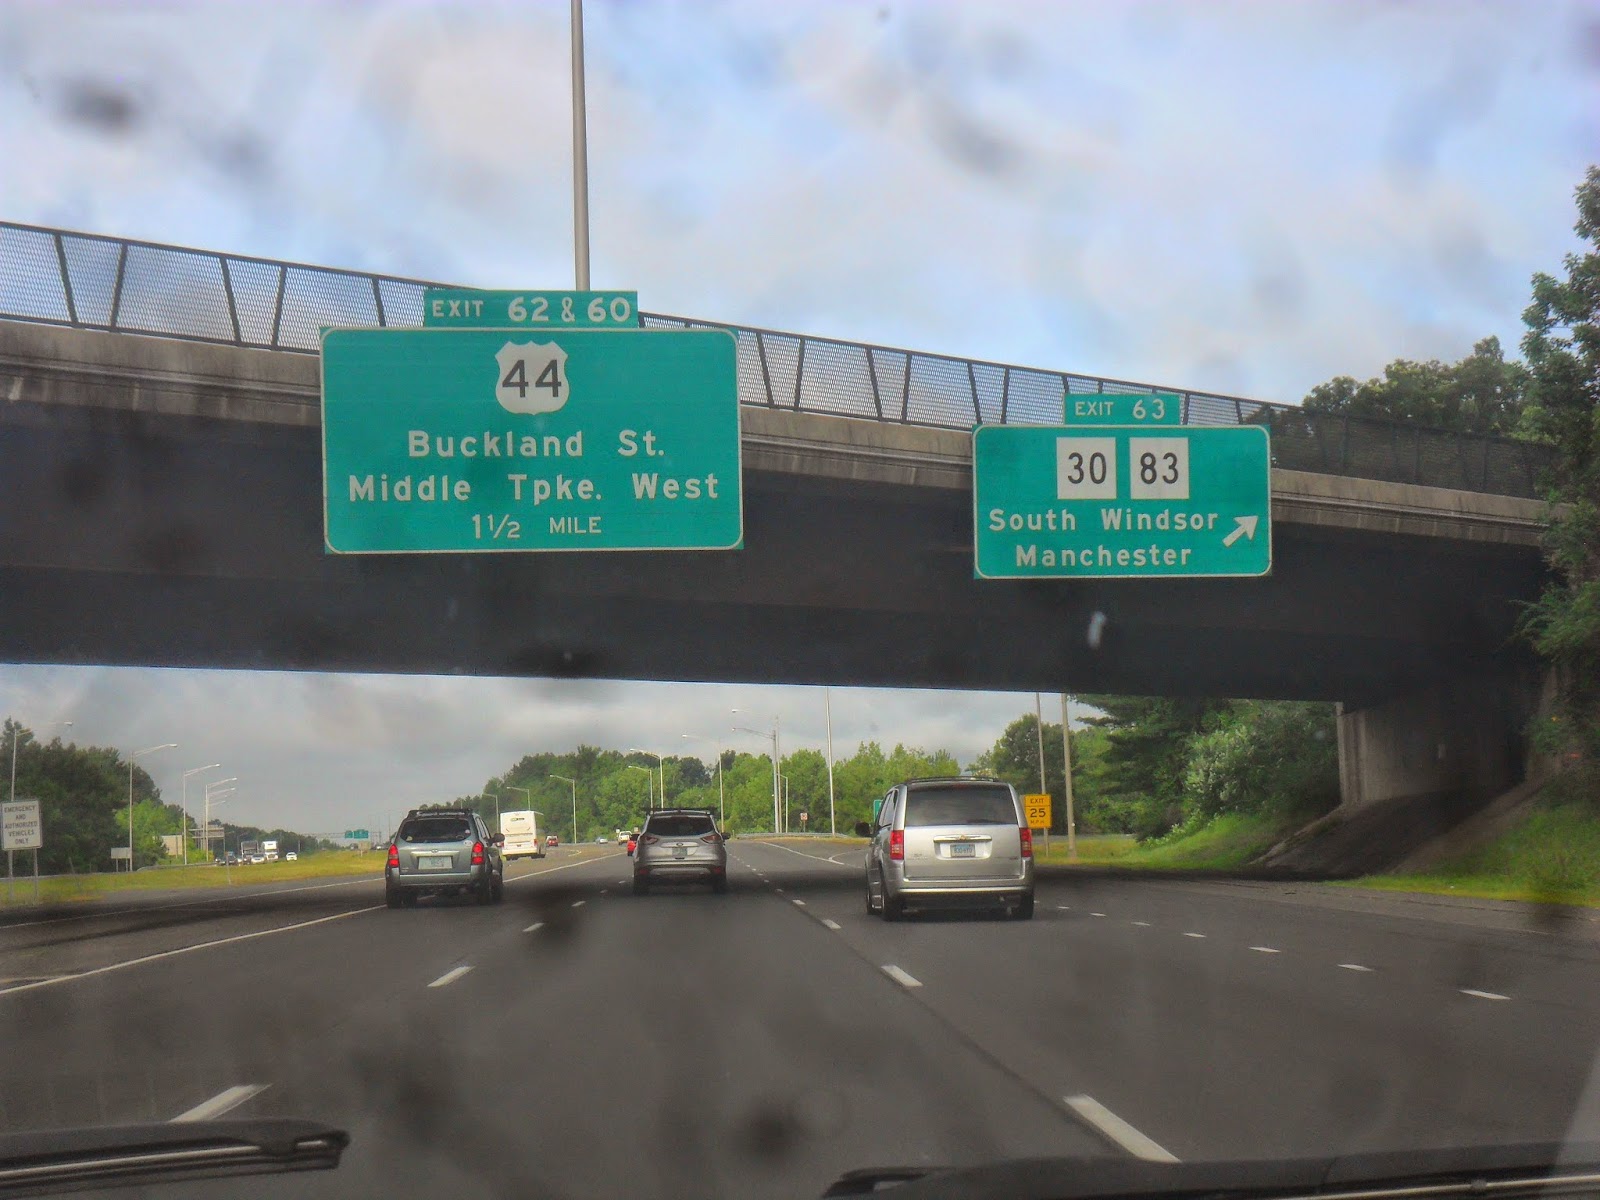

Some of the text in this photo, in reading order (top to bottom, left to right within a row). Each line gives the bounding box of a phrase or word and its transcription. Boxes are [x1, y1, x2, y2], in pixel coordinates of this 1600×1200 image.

[432, 296, 631, 322] EXIT 62 & 60
[502, 359, 562, 398] 44
[1074, 399, 1166, 420] EXIT 63
[408, 429, 665, 458] Buckland St.
[1067, 452, 1107, 485] 30
[1140, 452, 1179, 485] 83
[348, 473, 719, 507] Middle Tpke. West
[549, 516, 601, 535] MILE
[989, 508, 1219, 531] South Windsor
[1016, 545, 1192, 567] Manchester
[1030, 808, 1047, 818] 25
